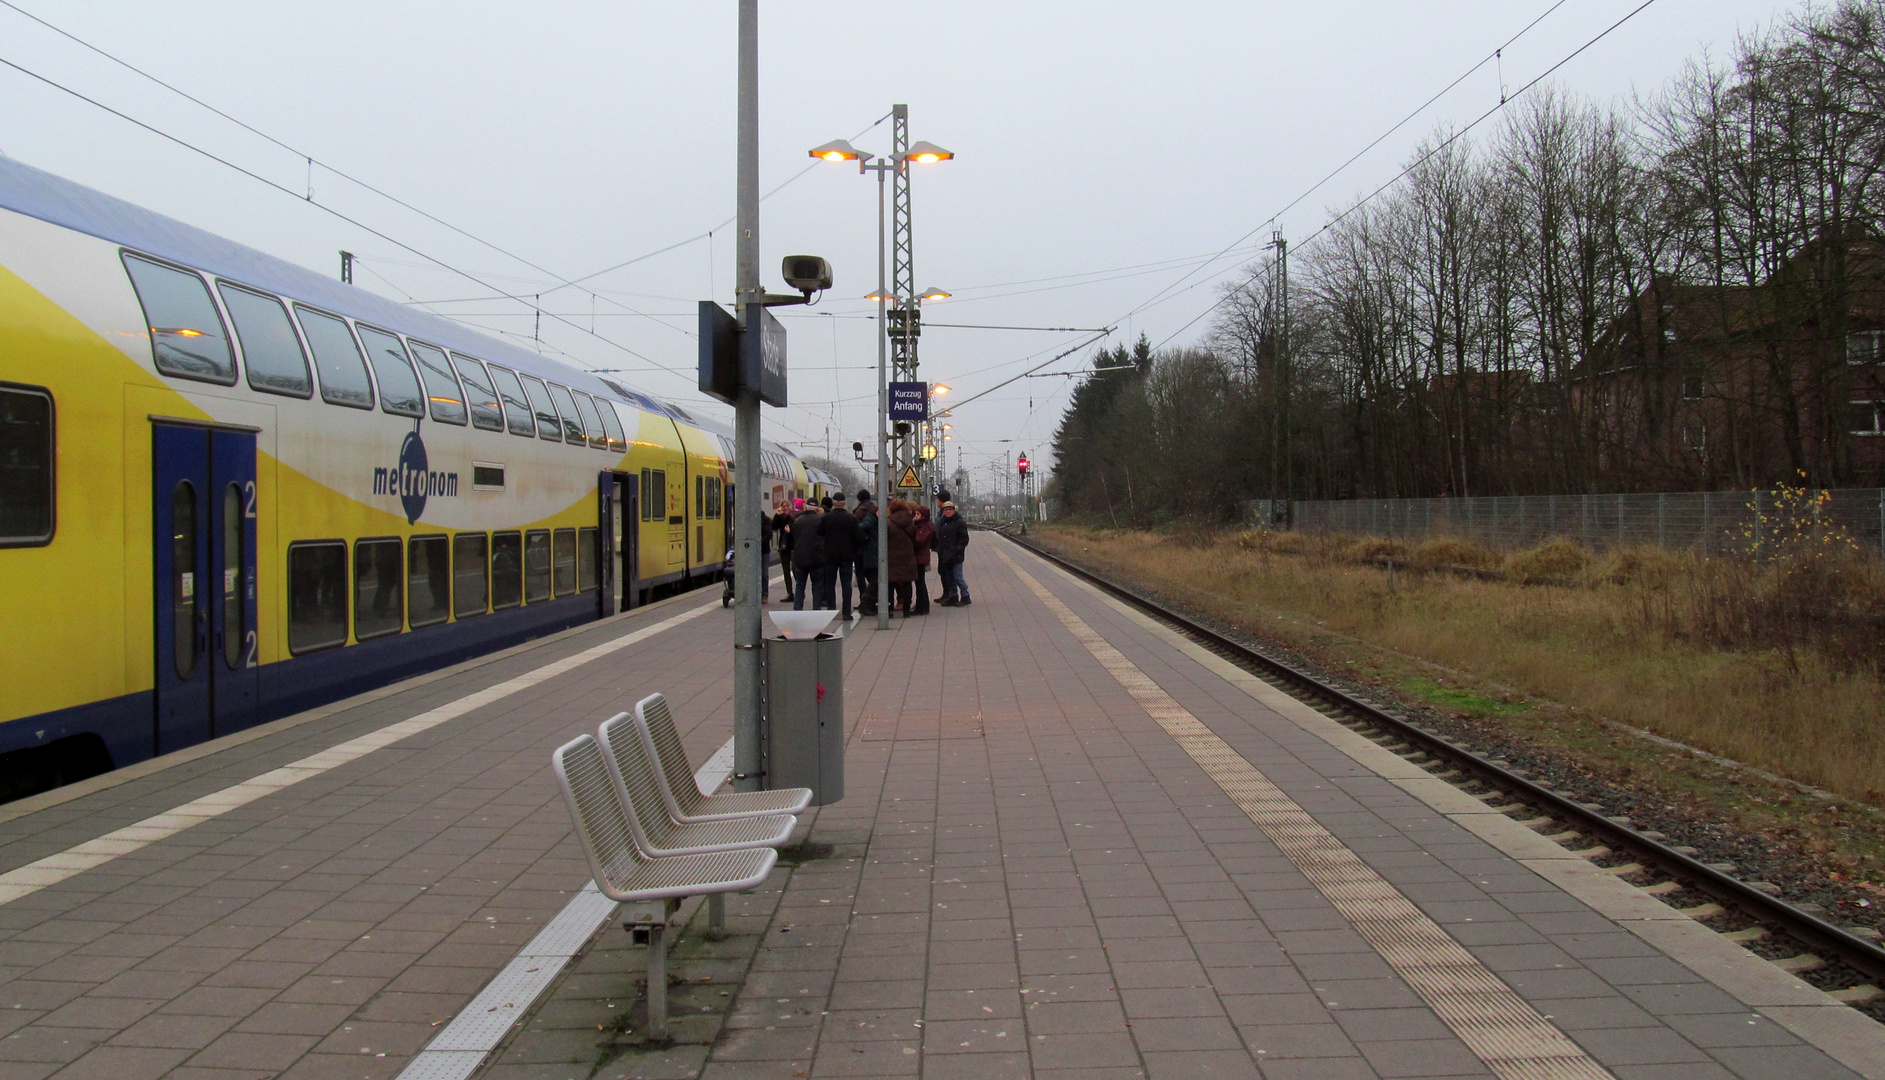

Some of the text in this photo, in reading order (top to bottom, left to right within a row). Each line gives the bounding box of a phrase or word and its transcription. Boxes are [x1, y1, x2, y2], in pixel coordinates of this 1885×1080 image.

[895, 390, 921, 398] Kurzzug
[894, 402, 923, 412] Anfang
[373, 462, 458, 497] metronom
[932, 484, 940, 495] 3
[245, 481, 256, 518] 2
[246, 630, 257, 669] 2
